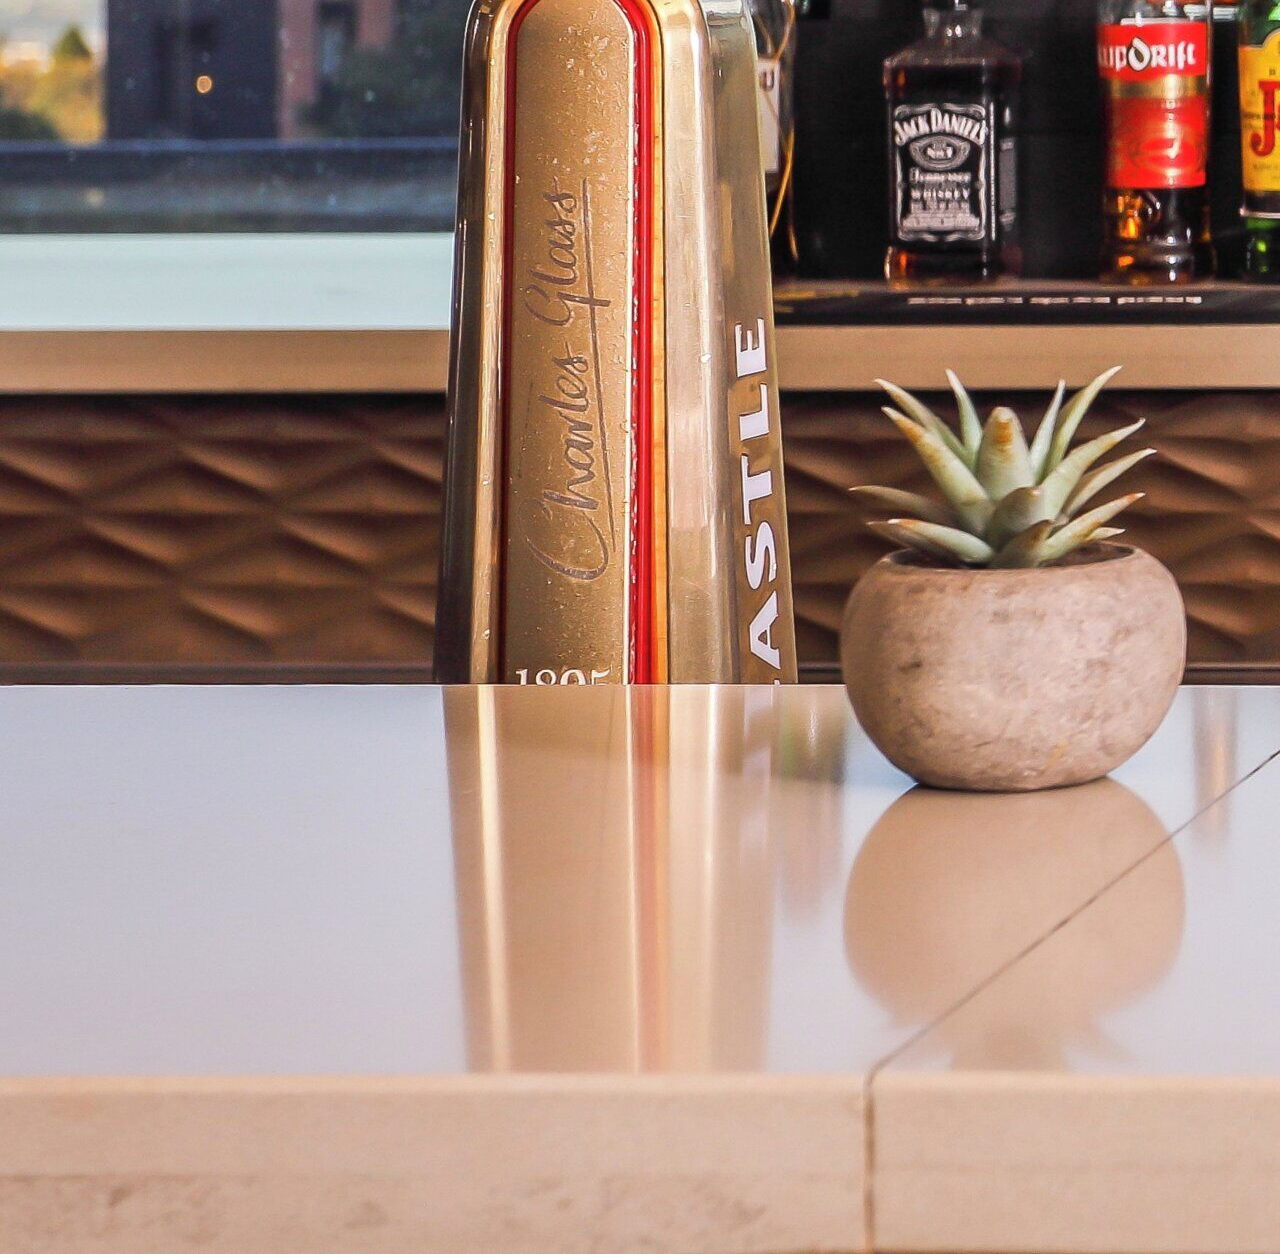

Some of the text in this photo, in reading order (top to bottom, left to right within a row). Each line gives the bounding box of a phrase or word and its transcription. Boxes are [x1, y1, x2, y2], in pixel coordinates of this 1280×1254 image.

[893, 114, 931, 146] JACK
[517, 175, 611, 582] Charles Glass
[734, 317, 784, 687] ASTLE
